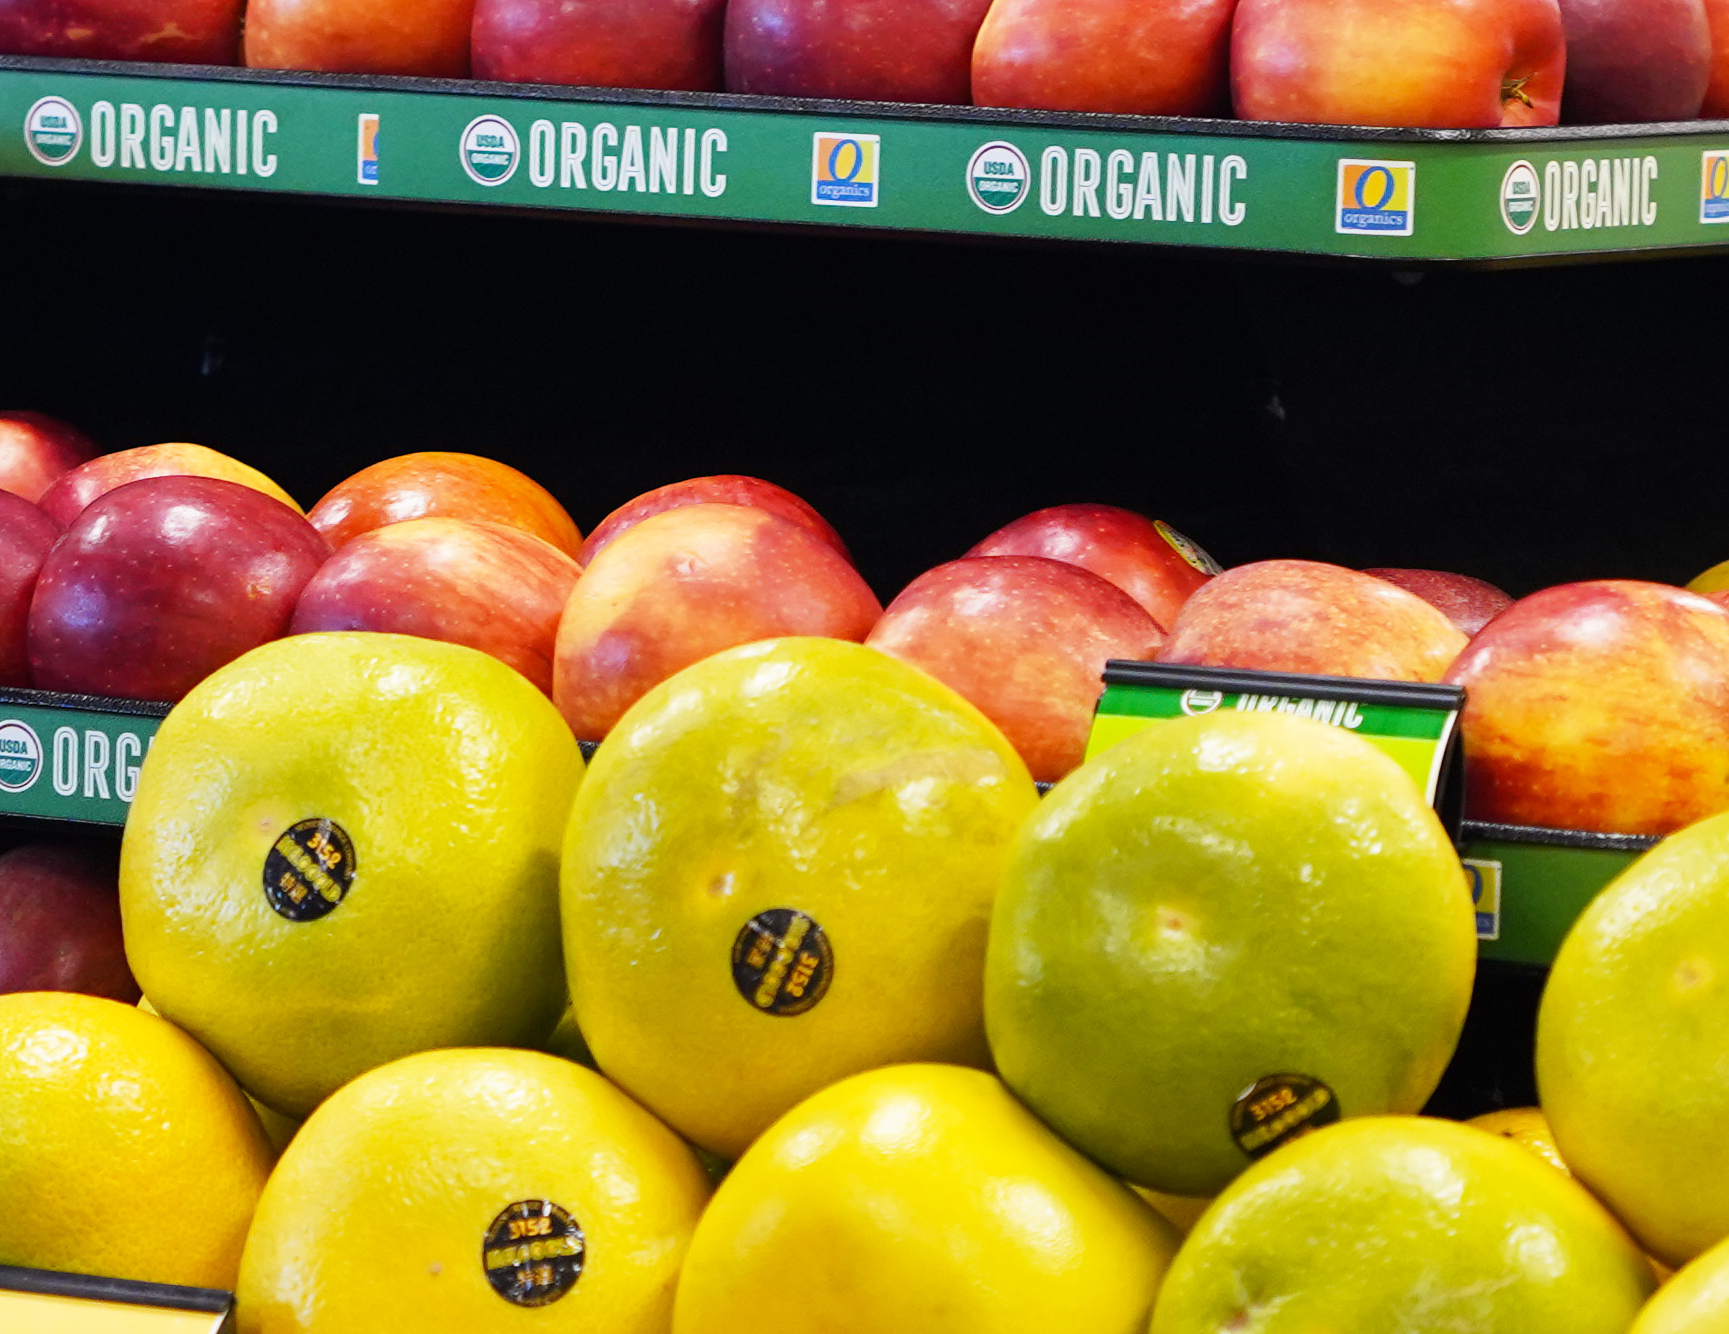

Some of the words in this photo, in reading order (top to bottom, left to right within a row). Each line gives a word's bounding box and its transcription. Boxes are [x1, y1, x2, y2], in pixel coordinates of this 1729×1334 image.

[90, 100, 278, 178] ORGANIC
[529, 119, 728, 198] ORGANIC
[983, 160, 1014, 176] USDA
[1040, 146, 1247, 227] ORGANIC
[1344, 211, 1403, 228] organics
[1543, 155, 1658, 232] ORGANIC
[52, 726, 155, 802] ORG
